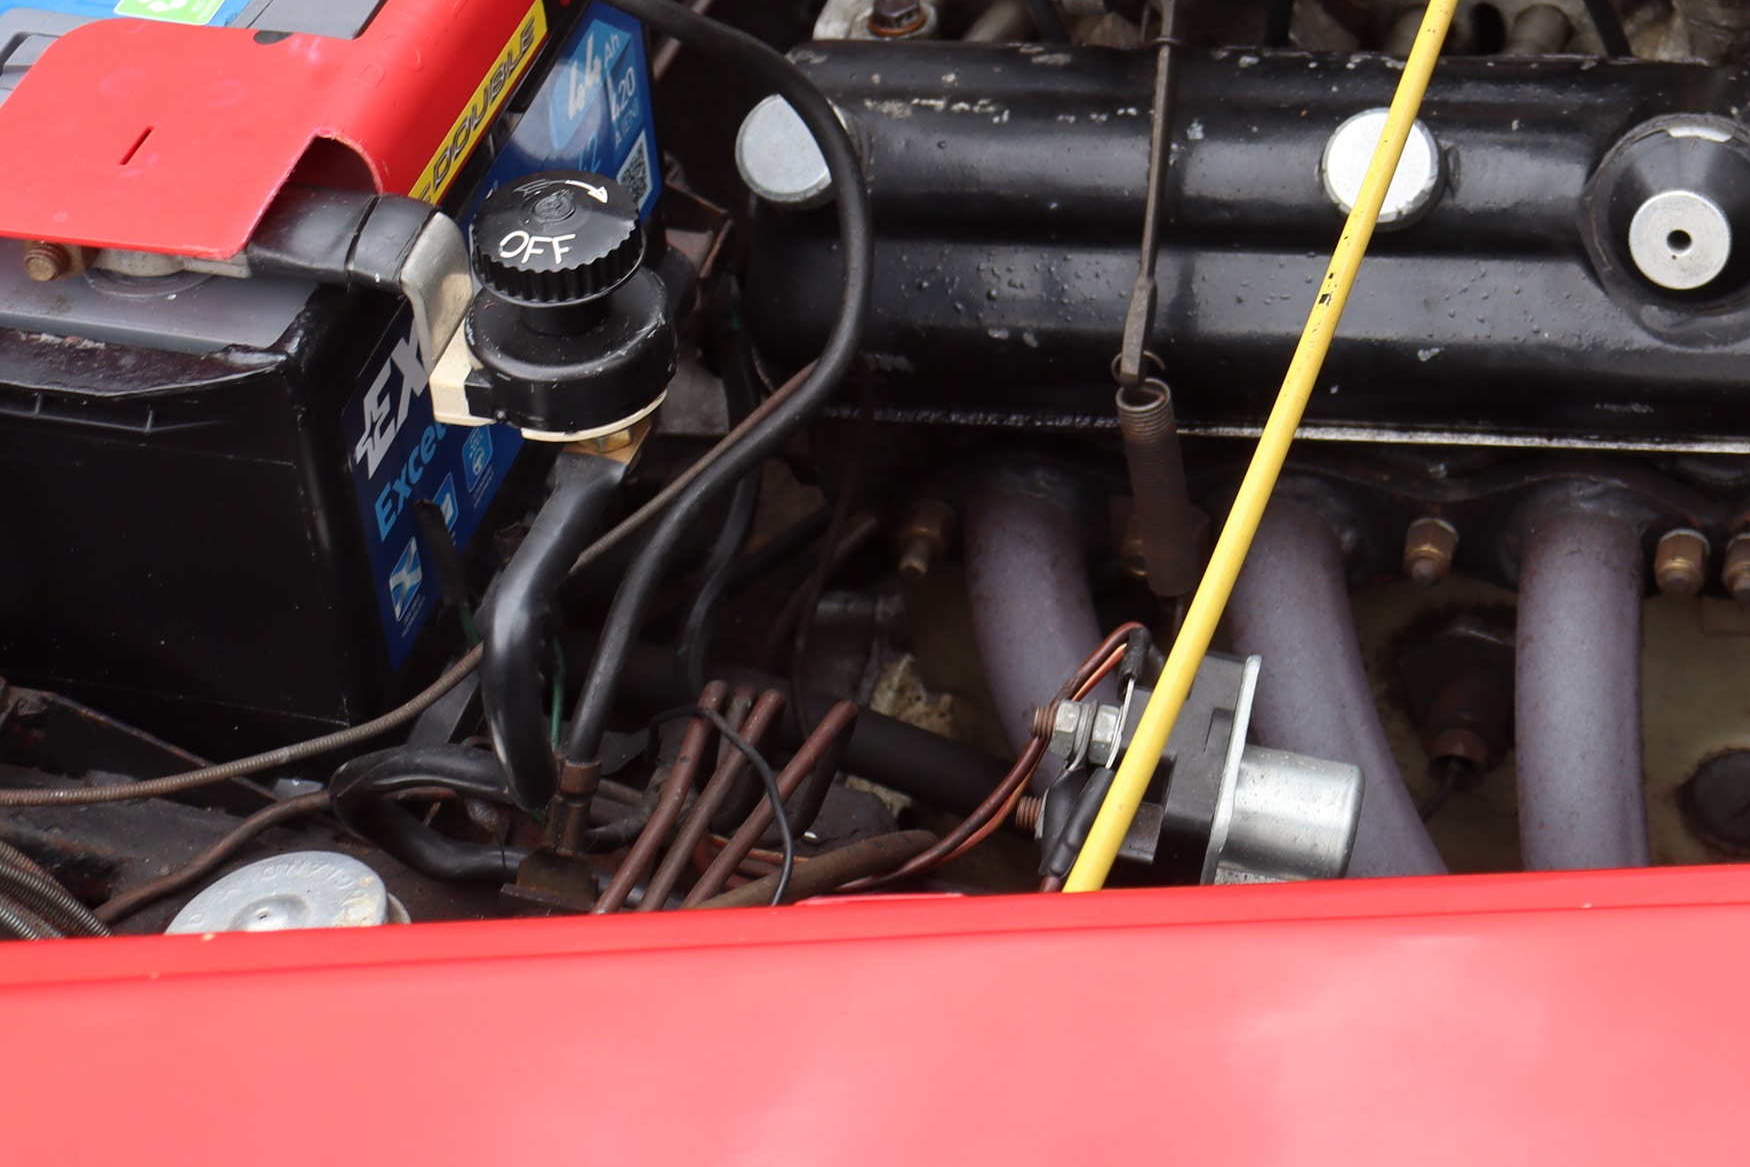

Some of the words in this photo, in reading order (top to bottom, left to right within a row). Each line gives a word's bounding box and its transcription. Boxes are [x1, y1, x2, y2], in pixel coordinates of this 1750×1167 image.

[433, 16, 535, 192] DOUBLE
[605, 66, 636, 123] 420
[499, 230, 576, 265] OFF
[355, 317, 430, 480] EX
